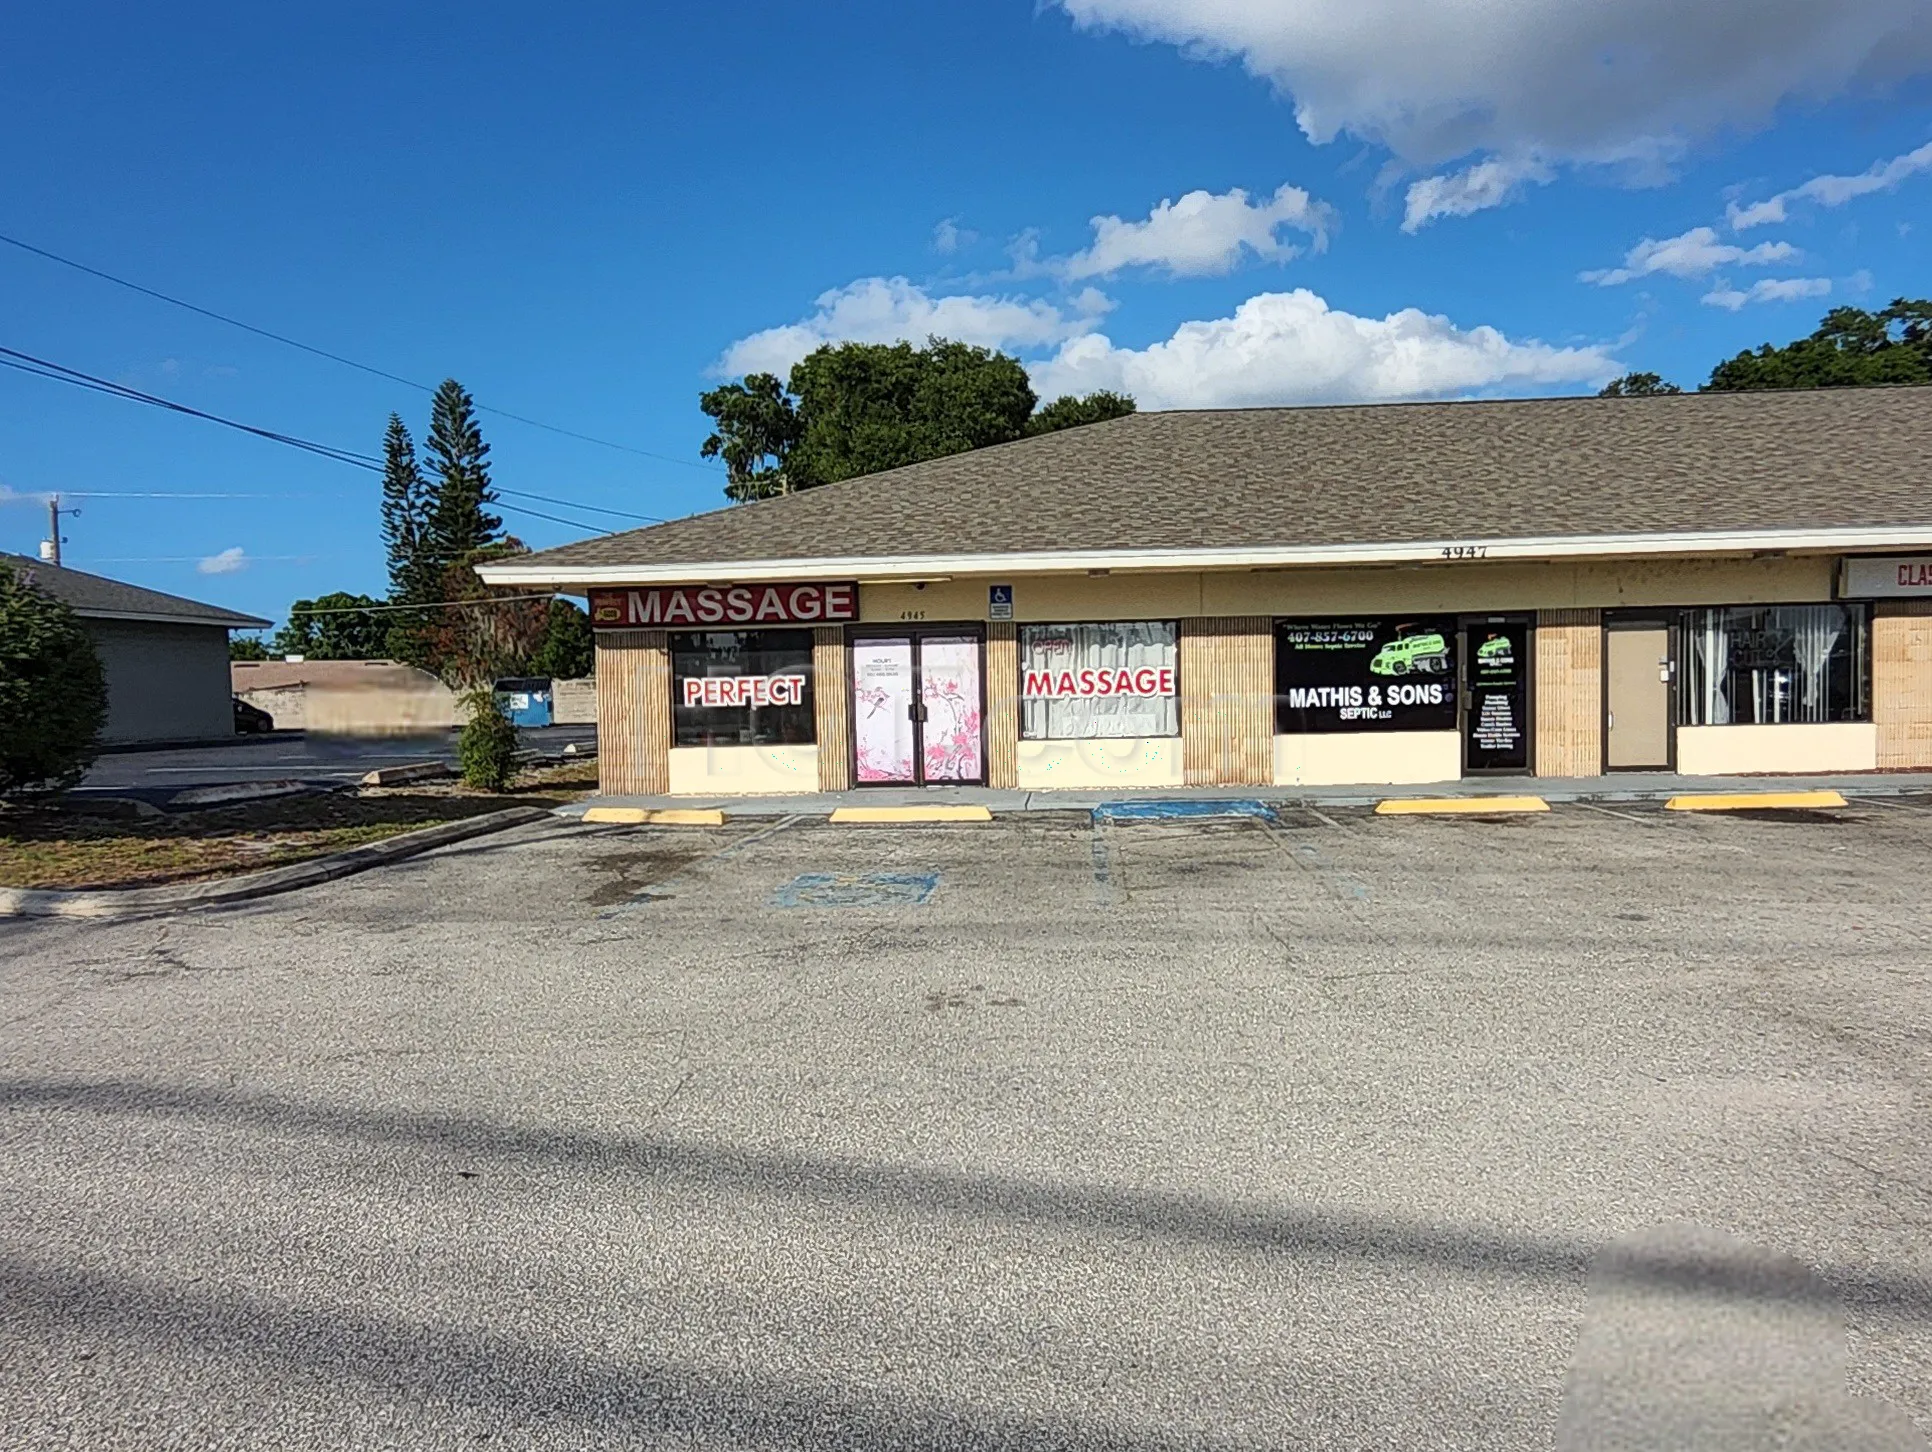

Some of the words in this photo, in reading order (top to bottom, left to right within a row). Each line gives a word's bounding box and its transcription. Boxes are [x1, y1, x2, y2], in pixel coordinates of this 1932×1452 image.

[1441, 546, 1488, 560] 4947
[627, 586, 851, 623] MASSAGE
[900, 610, 925, 620] 4945
[1287, 630, 1374, 642] 407-857-6700
[684, 676, 805, 707] PERFECT
[1024, 667, 1174, 697] MASSAGE
[1289, 687, 1364, 708] MATHIS
[1368, 685, 1382, 706] &
[1387, 684, 1443, 706] SONS
[1340, 707, 1377, 720] SEPTIC
[1378, 710, 1392, 718] LLC
